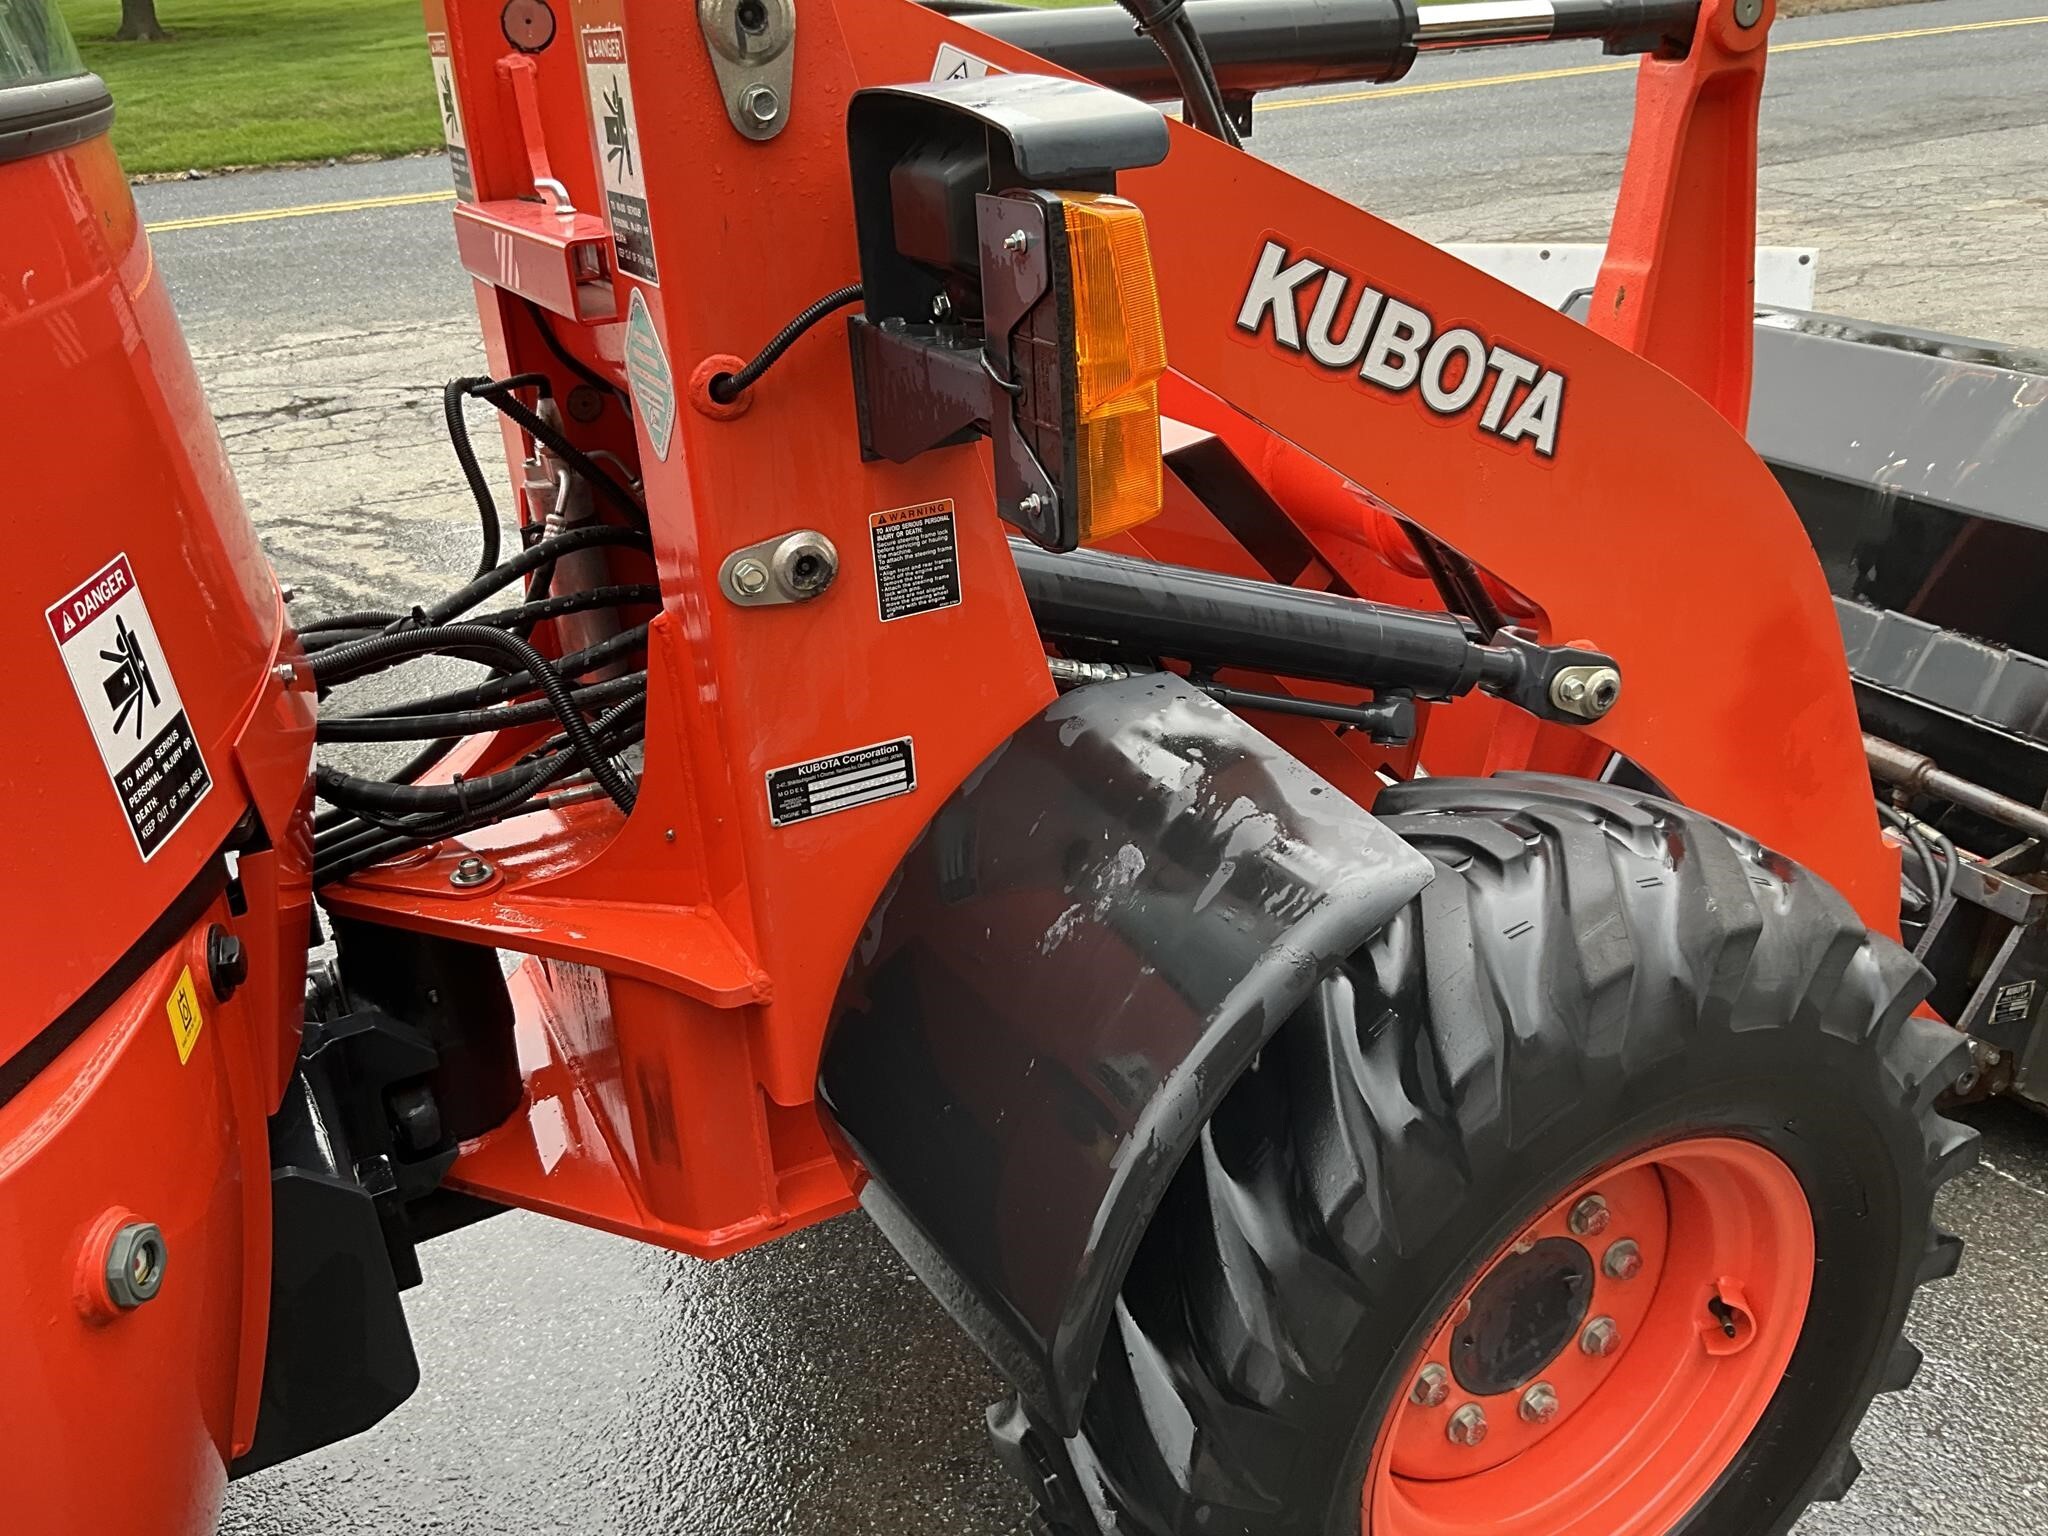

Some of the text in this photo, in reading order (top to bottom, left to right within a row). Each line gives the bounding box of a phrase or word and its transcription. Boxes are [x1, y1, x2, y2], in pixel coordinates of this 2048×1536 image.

[1236, 240, 1564, 456] KUBOTA
[888, 504, 945, 521] WARNING
[885, 524, 901, 533] AVOID
[901, 520, 923, 530] SERIOUS
[924, 515, 950, 525] PERSONAL
[876, 532, 894, 541] INJURY
[877, 540, 896, 548] Secure
[897, 535, 920, 544] steering
[877, 546, 895, 554] before
[896, 541, 920, 550] servicing
[928, 535, 948, 544] hauling
[886, 555, 903, 564] attach
[914, 549, 937, 558] steering
[73, 568, 127, 622] DANGER
[122, 729, 180, 791] TO AVOID SERIOUS
[798, 745, 899, 776] KUBOTA Corporation
[128, 737, 193, 808] PERSONAL INJURY OR
[777, 786, 804, 797] MODEL
[135, 797, 159, 824] DEATH:
[141, 819, 156, 839] KEEP
[157, 805, 169, 823] OUT
[169, 795, 178, 809] OF
[177, 782, 191, 799] THIS
[189, 768, 203, 787] AREA
[780, 810, 800, 820] ENGINE
